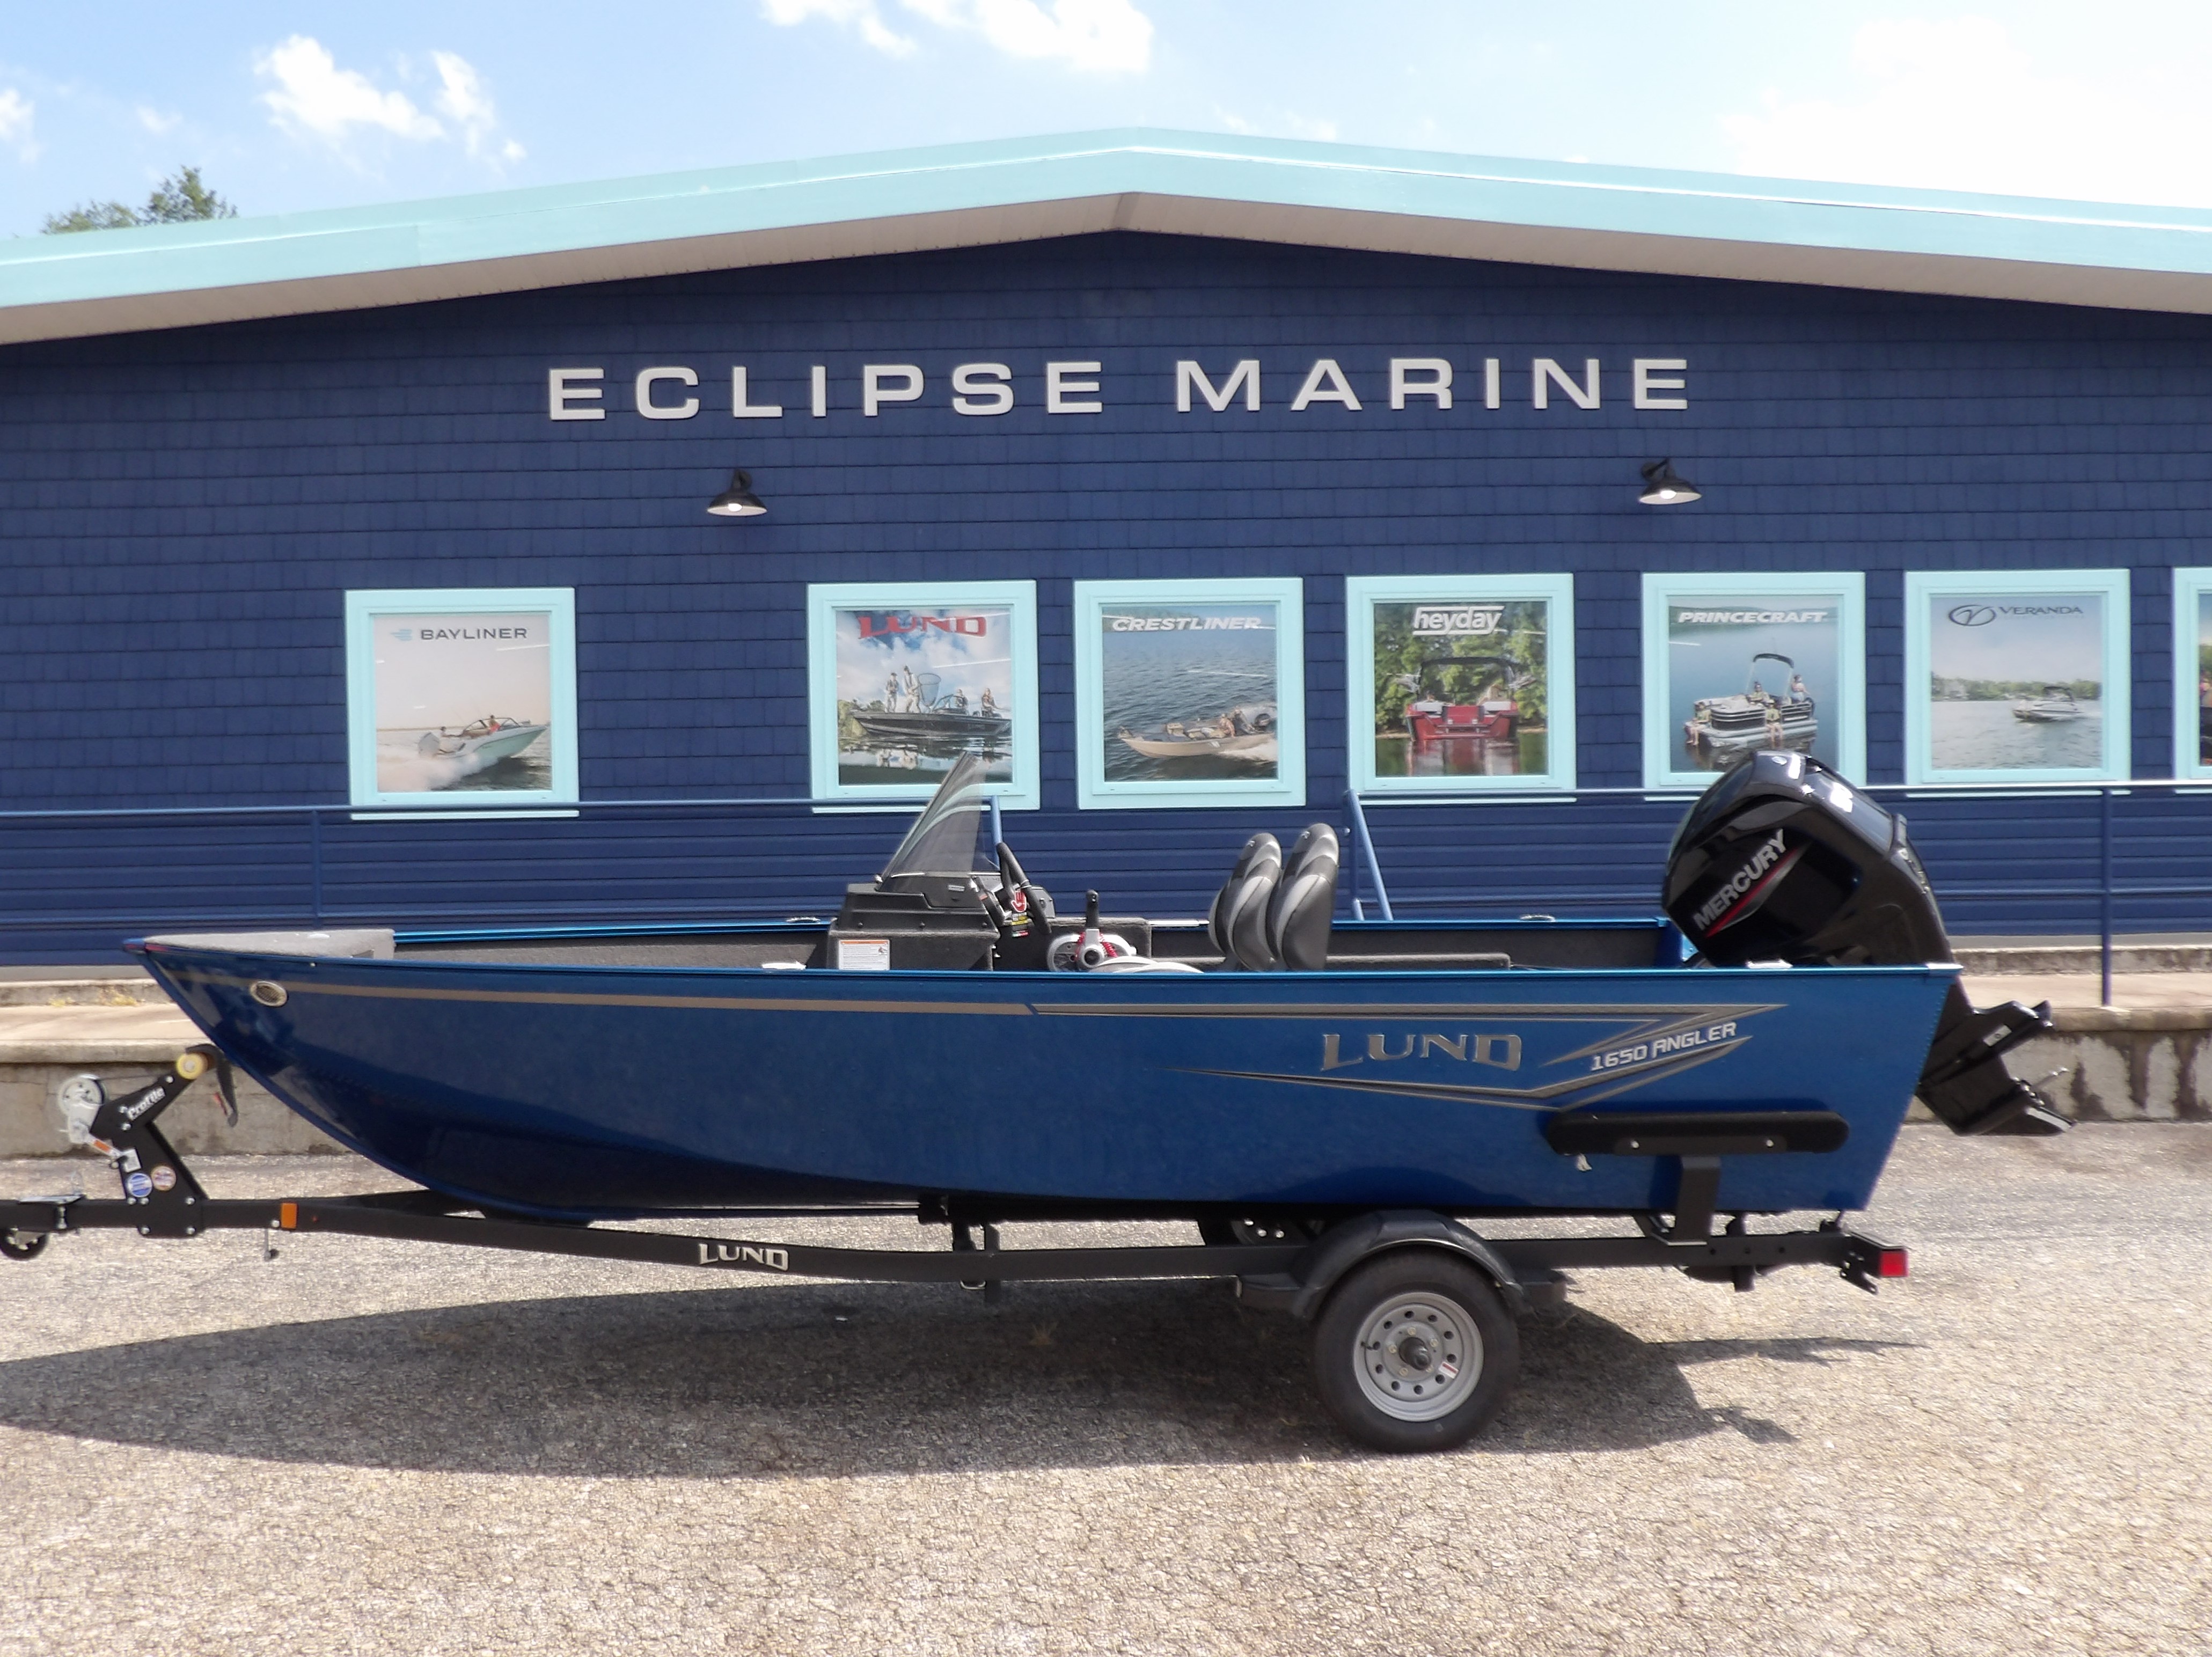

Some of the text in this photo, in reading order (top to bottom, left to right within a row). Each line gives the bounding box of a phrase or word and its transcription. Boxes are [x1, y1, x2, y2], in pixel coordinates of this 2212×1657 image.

[549, 358, 1688, 421] ECLIPSE MARINE
[1112, 617, 1262, 632] CRESTLINER
[1412, 606, 1505, 635] heyday
[1678, 612, 1828, 623] PRINCECRAFT
[1999, 606, 2083, 615] VERANDA
[420, 627, 528, 641] BAYLINER
[857, 615, 987, 639] LUND
[1693, 828, 1786, 930] MERCURY
[1321, 1033, 1522, 1071] LUND
[1590, 1021, 1737, 1072] 1650 ANGLER
[698, 1242, 789, 1272] LUND
